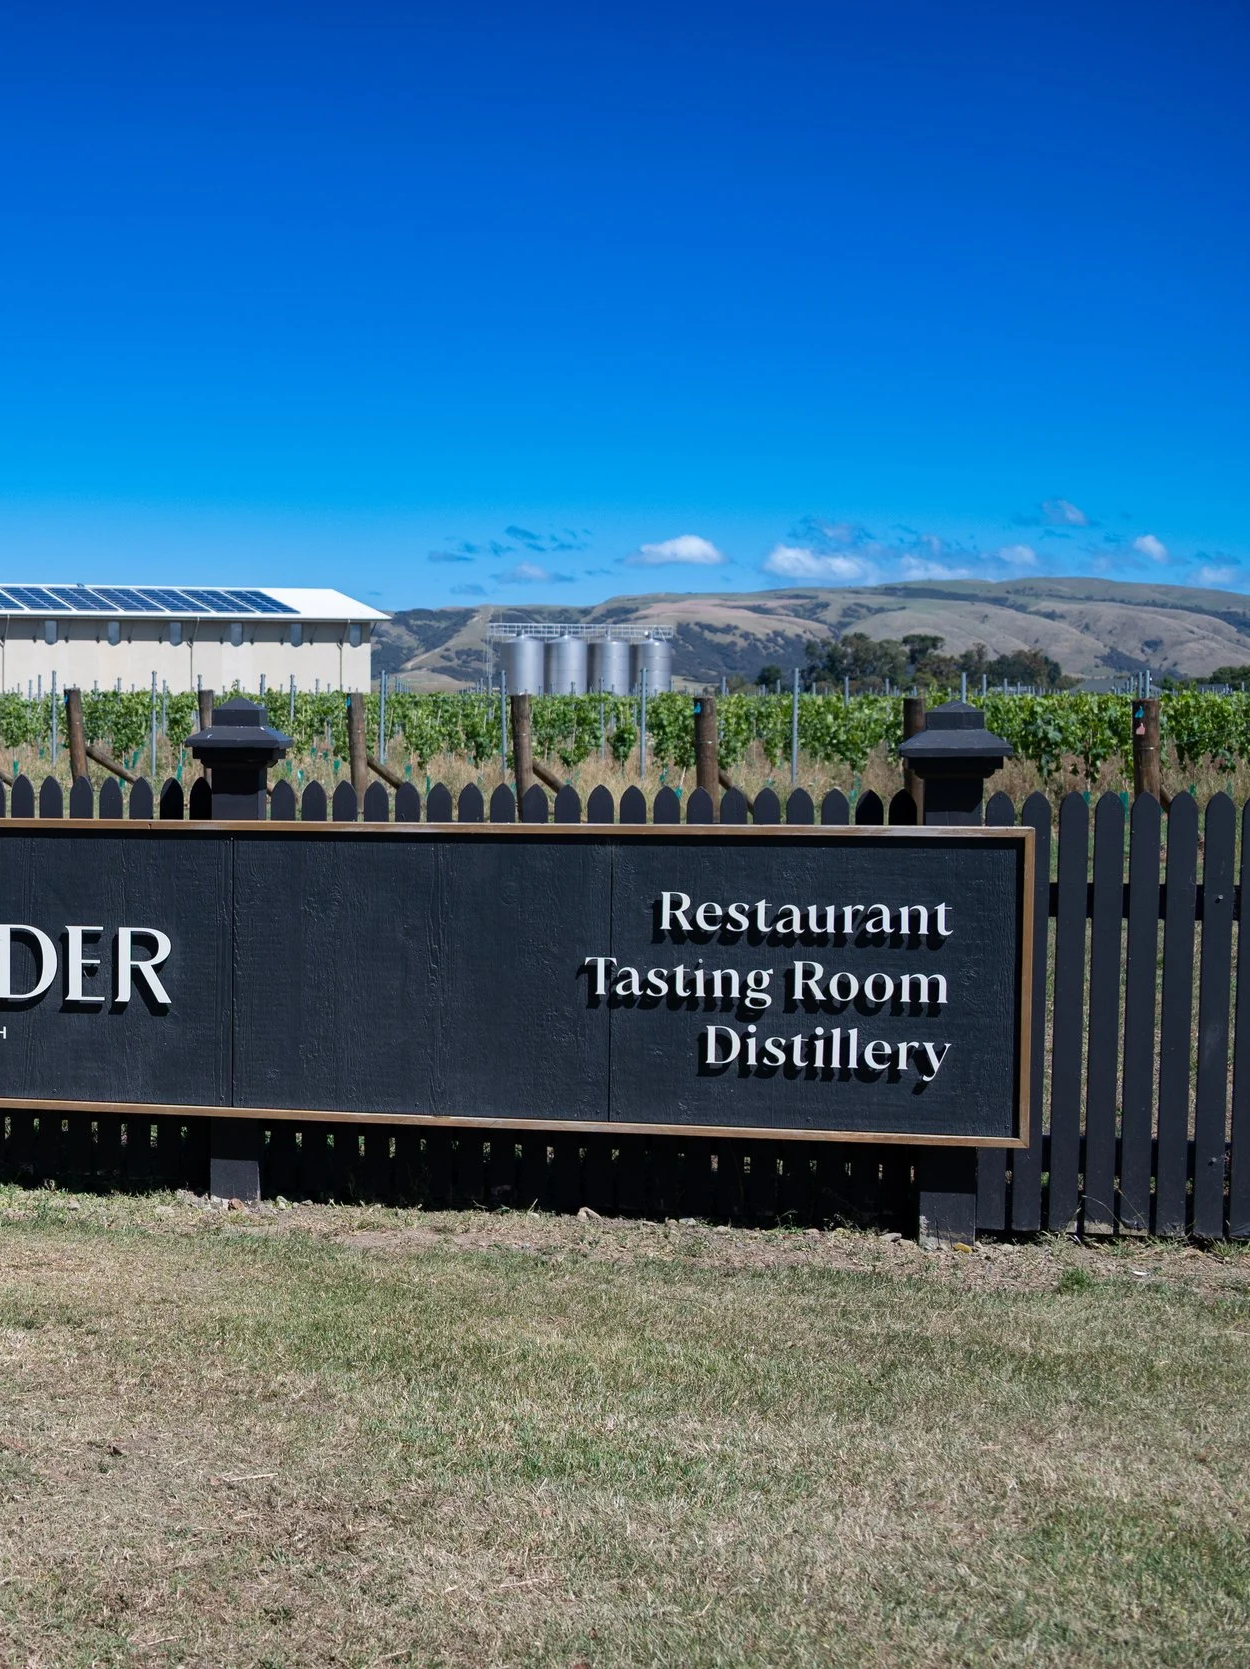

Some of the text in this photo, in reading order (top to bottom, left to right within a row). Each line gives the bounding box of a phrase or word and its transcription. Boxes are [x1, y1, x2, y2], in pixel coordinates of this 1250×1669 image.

[659, 890, 954, 937] Restaurant
[584, 956, 949, 1009] Tasting Room
[705, 1024, 952, 1082] Distillery
